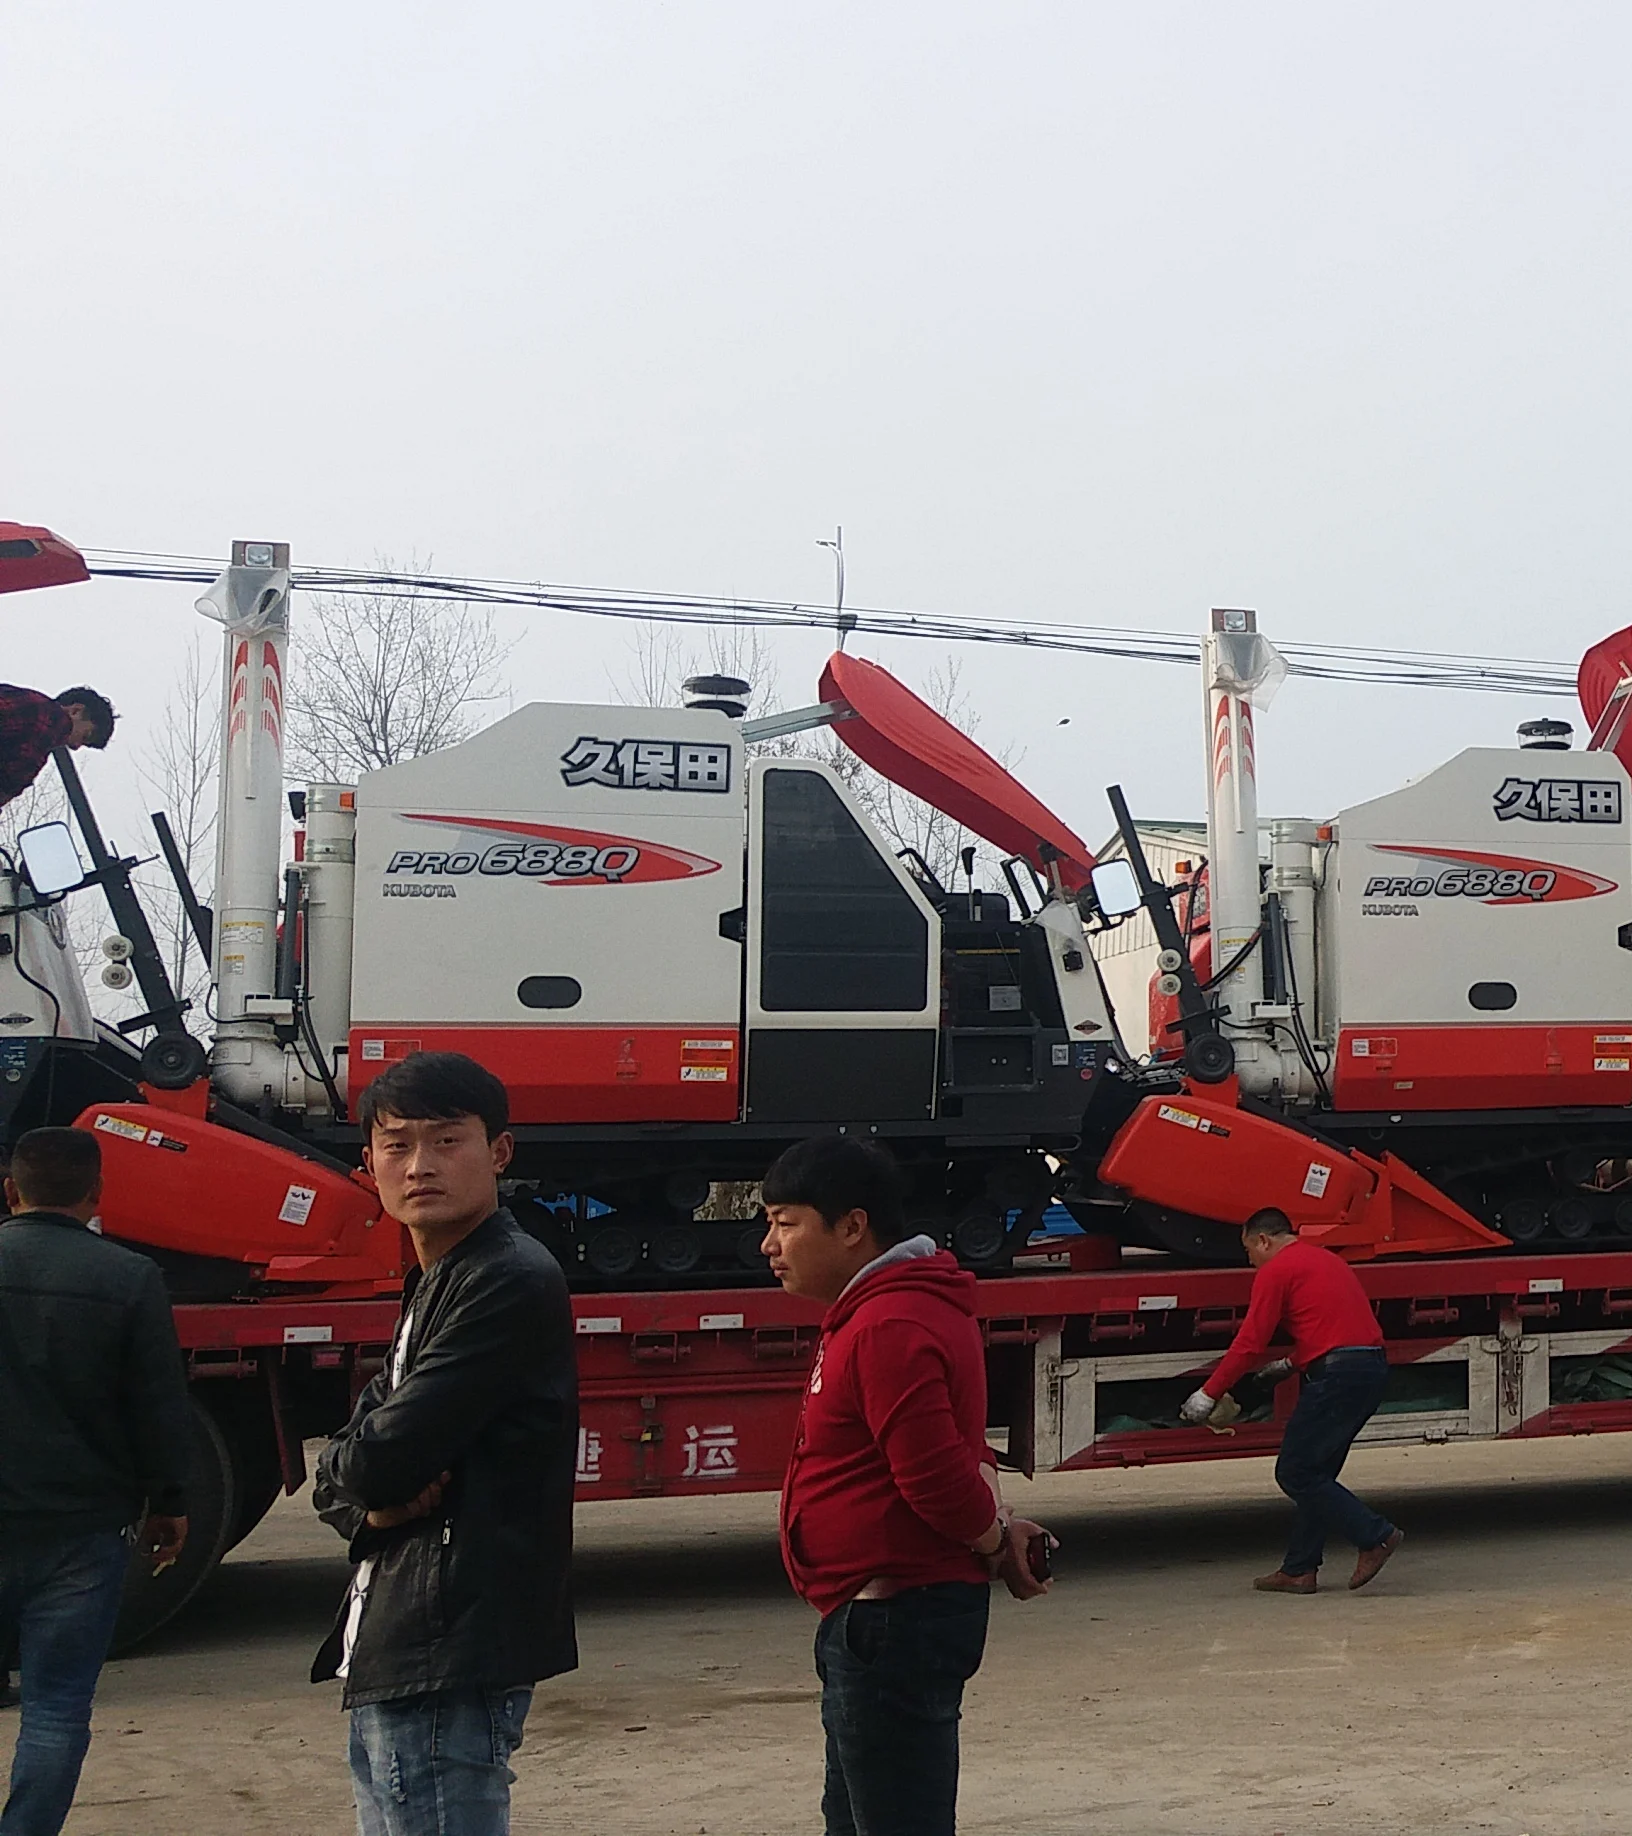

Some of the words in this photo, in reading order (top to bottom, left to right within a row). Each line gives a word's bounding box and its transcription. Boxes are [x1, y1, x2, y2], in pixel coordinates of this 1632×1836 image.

[561, 737, 731, 793] 久保田
[1493, 778, 1621, 823] 久保田
[382, 884, 456, 897] KUBOTA
[1362, 904, 1419, 916] KUBOTA
